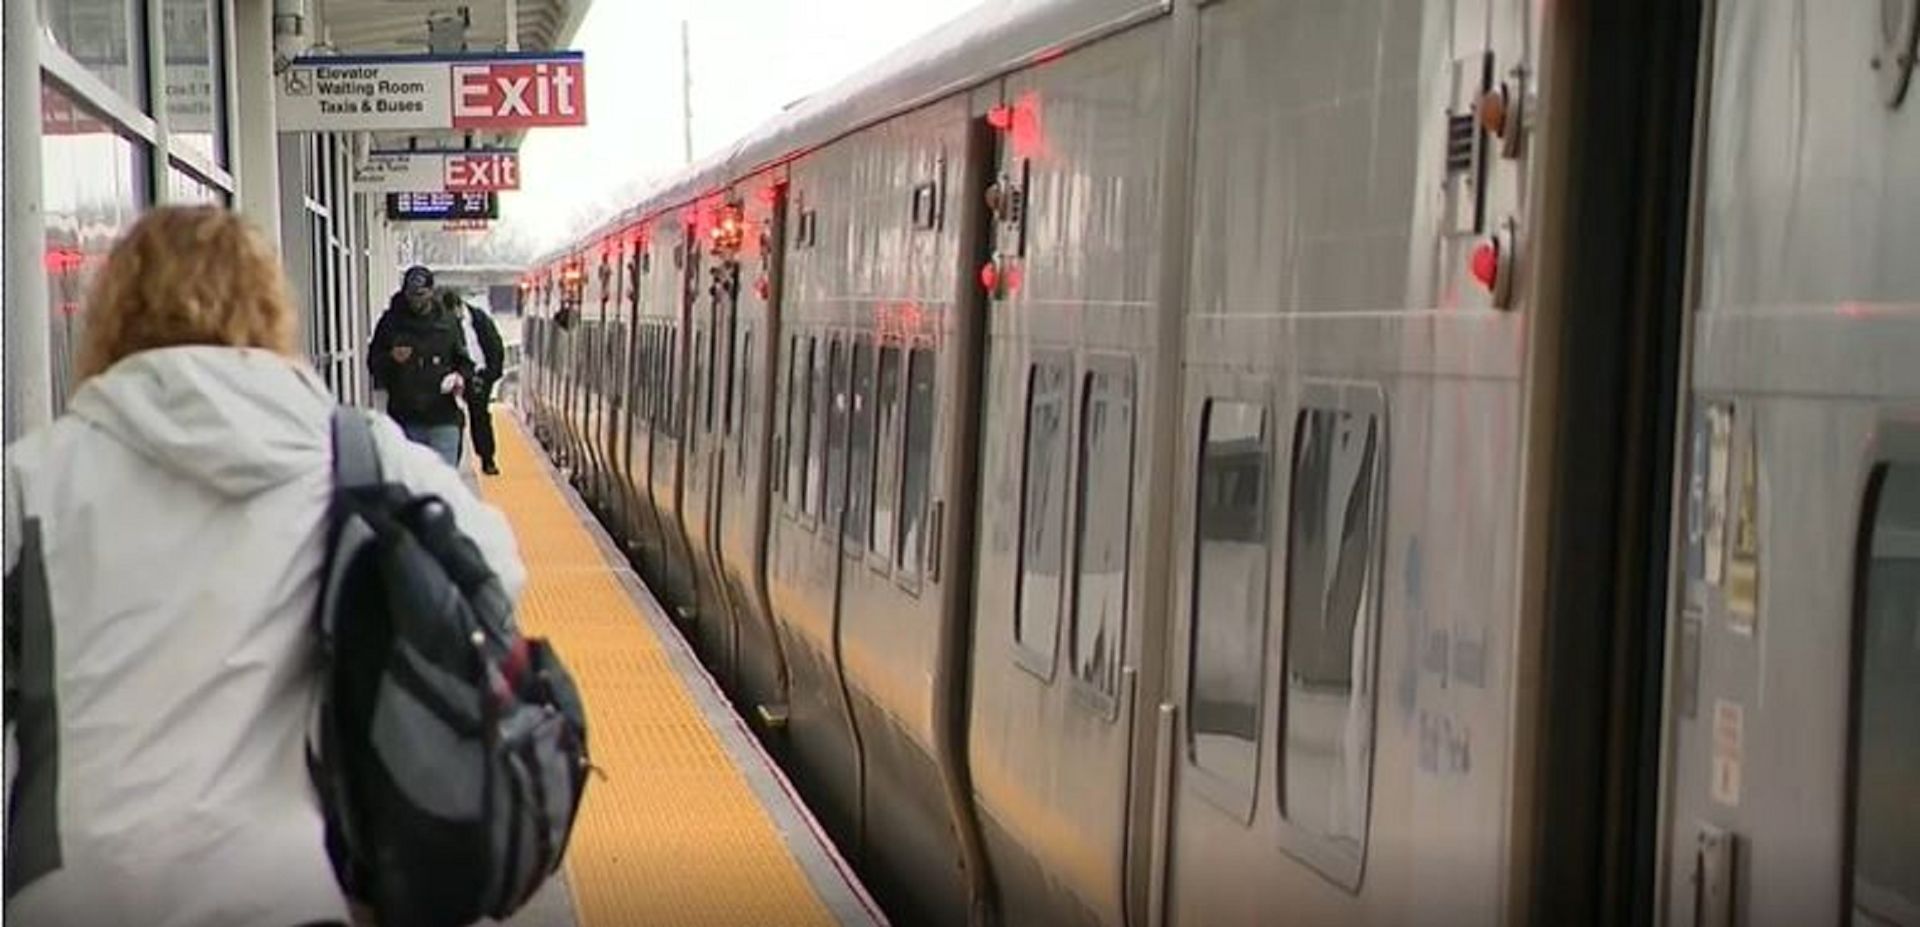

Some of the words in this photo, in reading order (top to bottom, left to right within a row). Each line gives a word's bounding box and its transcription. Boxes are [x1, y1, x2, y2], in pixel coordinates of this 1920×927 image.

[317, 67, 378, 79] Elevator
[317, 81, 375, 96] Waiting
[379, 81, 424, 93] Room
[453, 63, 575, 117] Exit
[320, 100, 357, 113] Taxis
[361, 100, 371, 112] &
[376, 99, 423, 112] Buses
[446, 153, 514, 186] Exit
